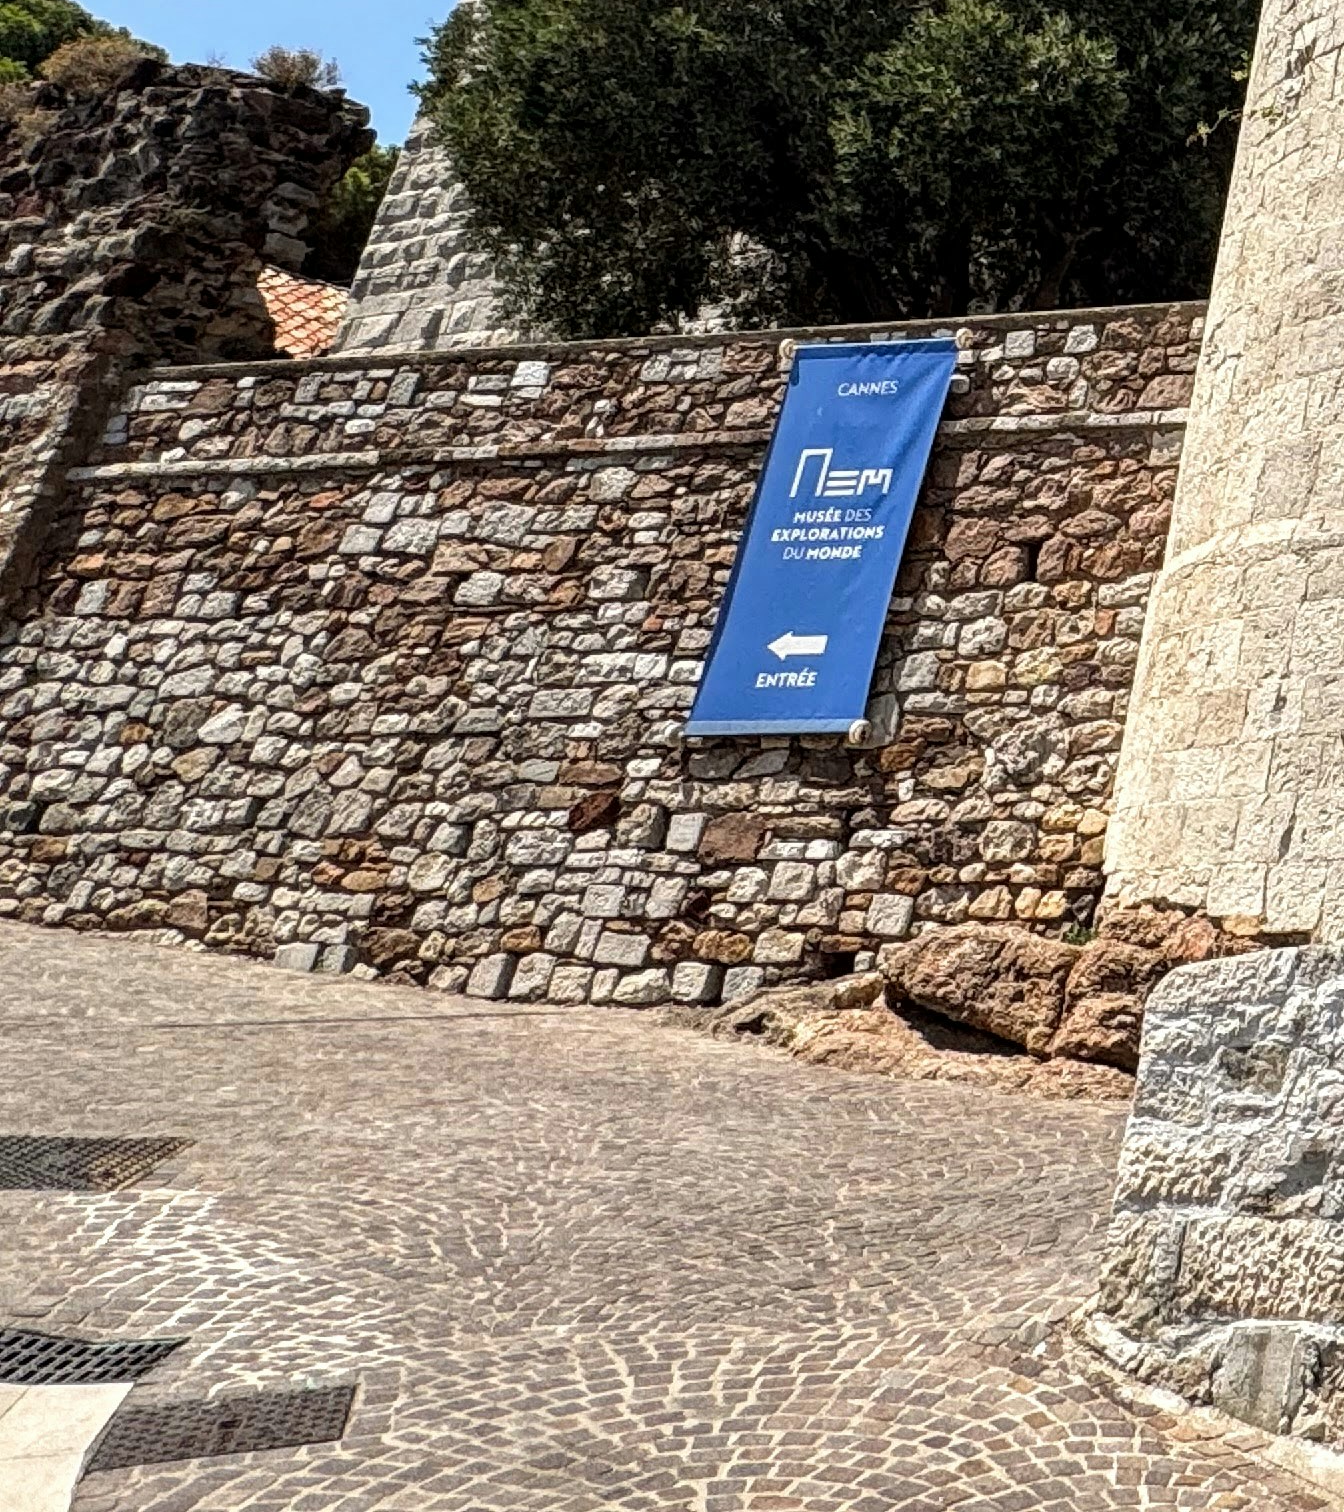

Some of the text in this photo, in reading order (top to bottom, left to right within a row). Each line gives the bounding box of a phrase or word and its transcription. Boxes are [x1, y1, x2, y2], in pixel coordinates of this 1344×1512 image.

[838, 380, 899, 396] CANNES
[793, 506, 872, 524] MUSÉE DES
[770, 524, 885, 542] EXPLORATIONS
[783, 544, 862, 560] DU MONDE
[755, 668, 818, 689] ENTRÉE
